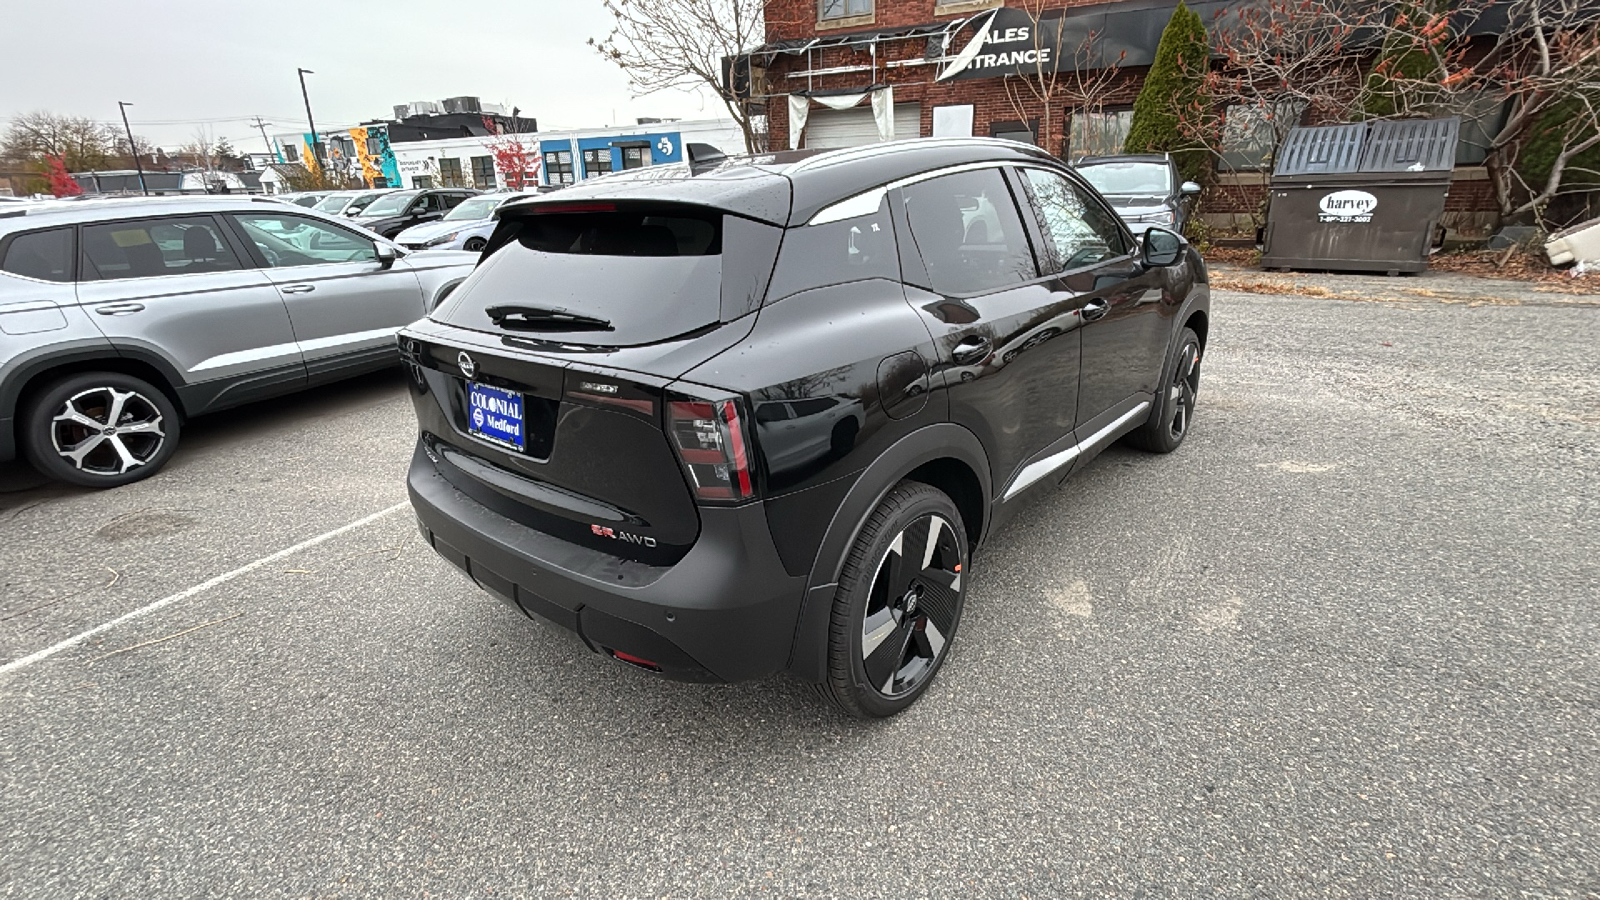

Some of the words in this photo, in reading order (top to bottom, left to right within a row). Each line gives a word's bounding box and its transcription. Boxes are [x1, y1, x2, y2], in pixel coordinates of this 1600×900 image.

[982, 27, 1030, 45] ALES
[967, 48, 1051, 69] TRANCE
[1326, 196, 1374, 213] harvey
[471, 391, 523, 420] COLONIAL
[486, 414, 520, 436] Medford
[619, 531, 657, 548] AWD
